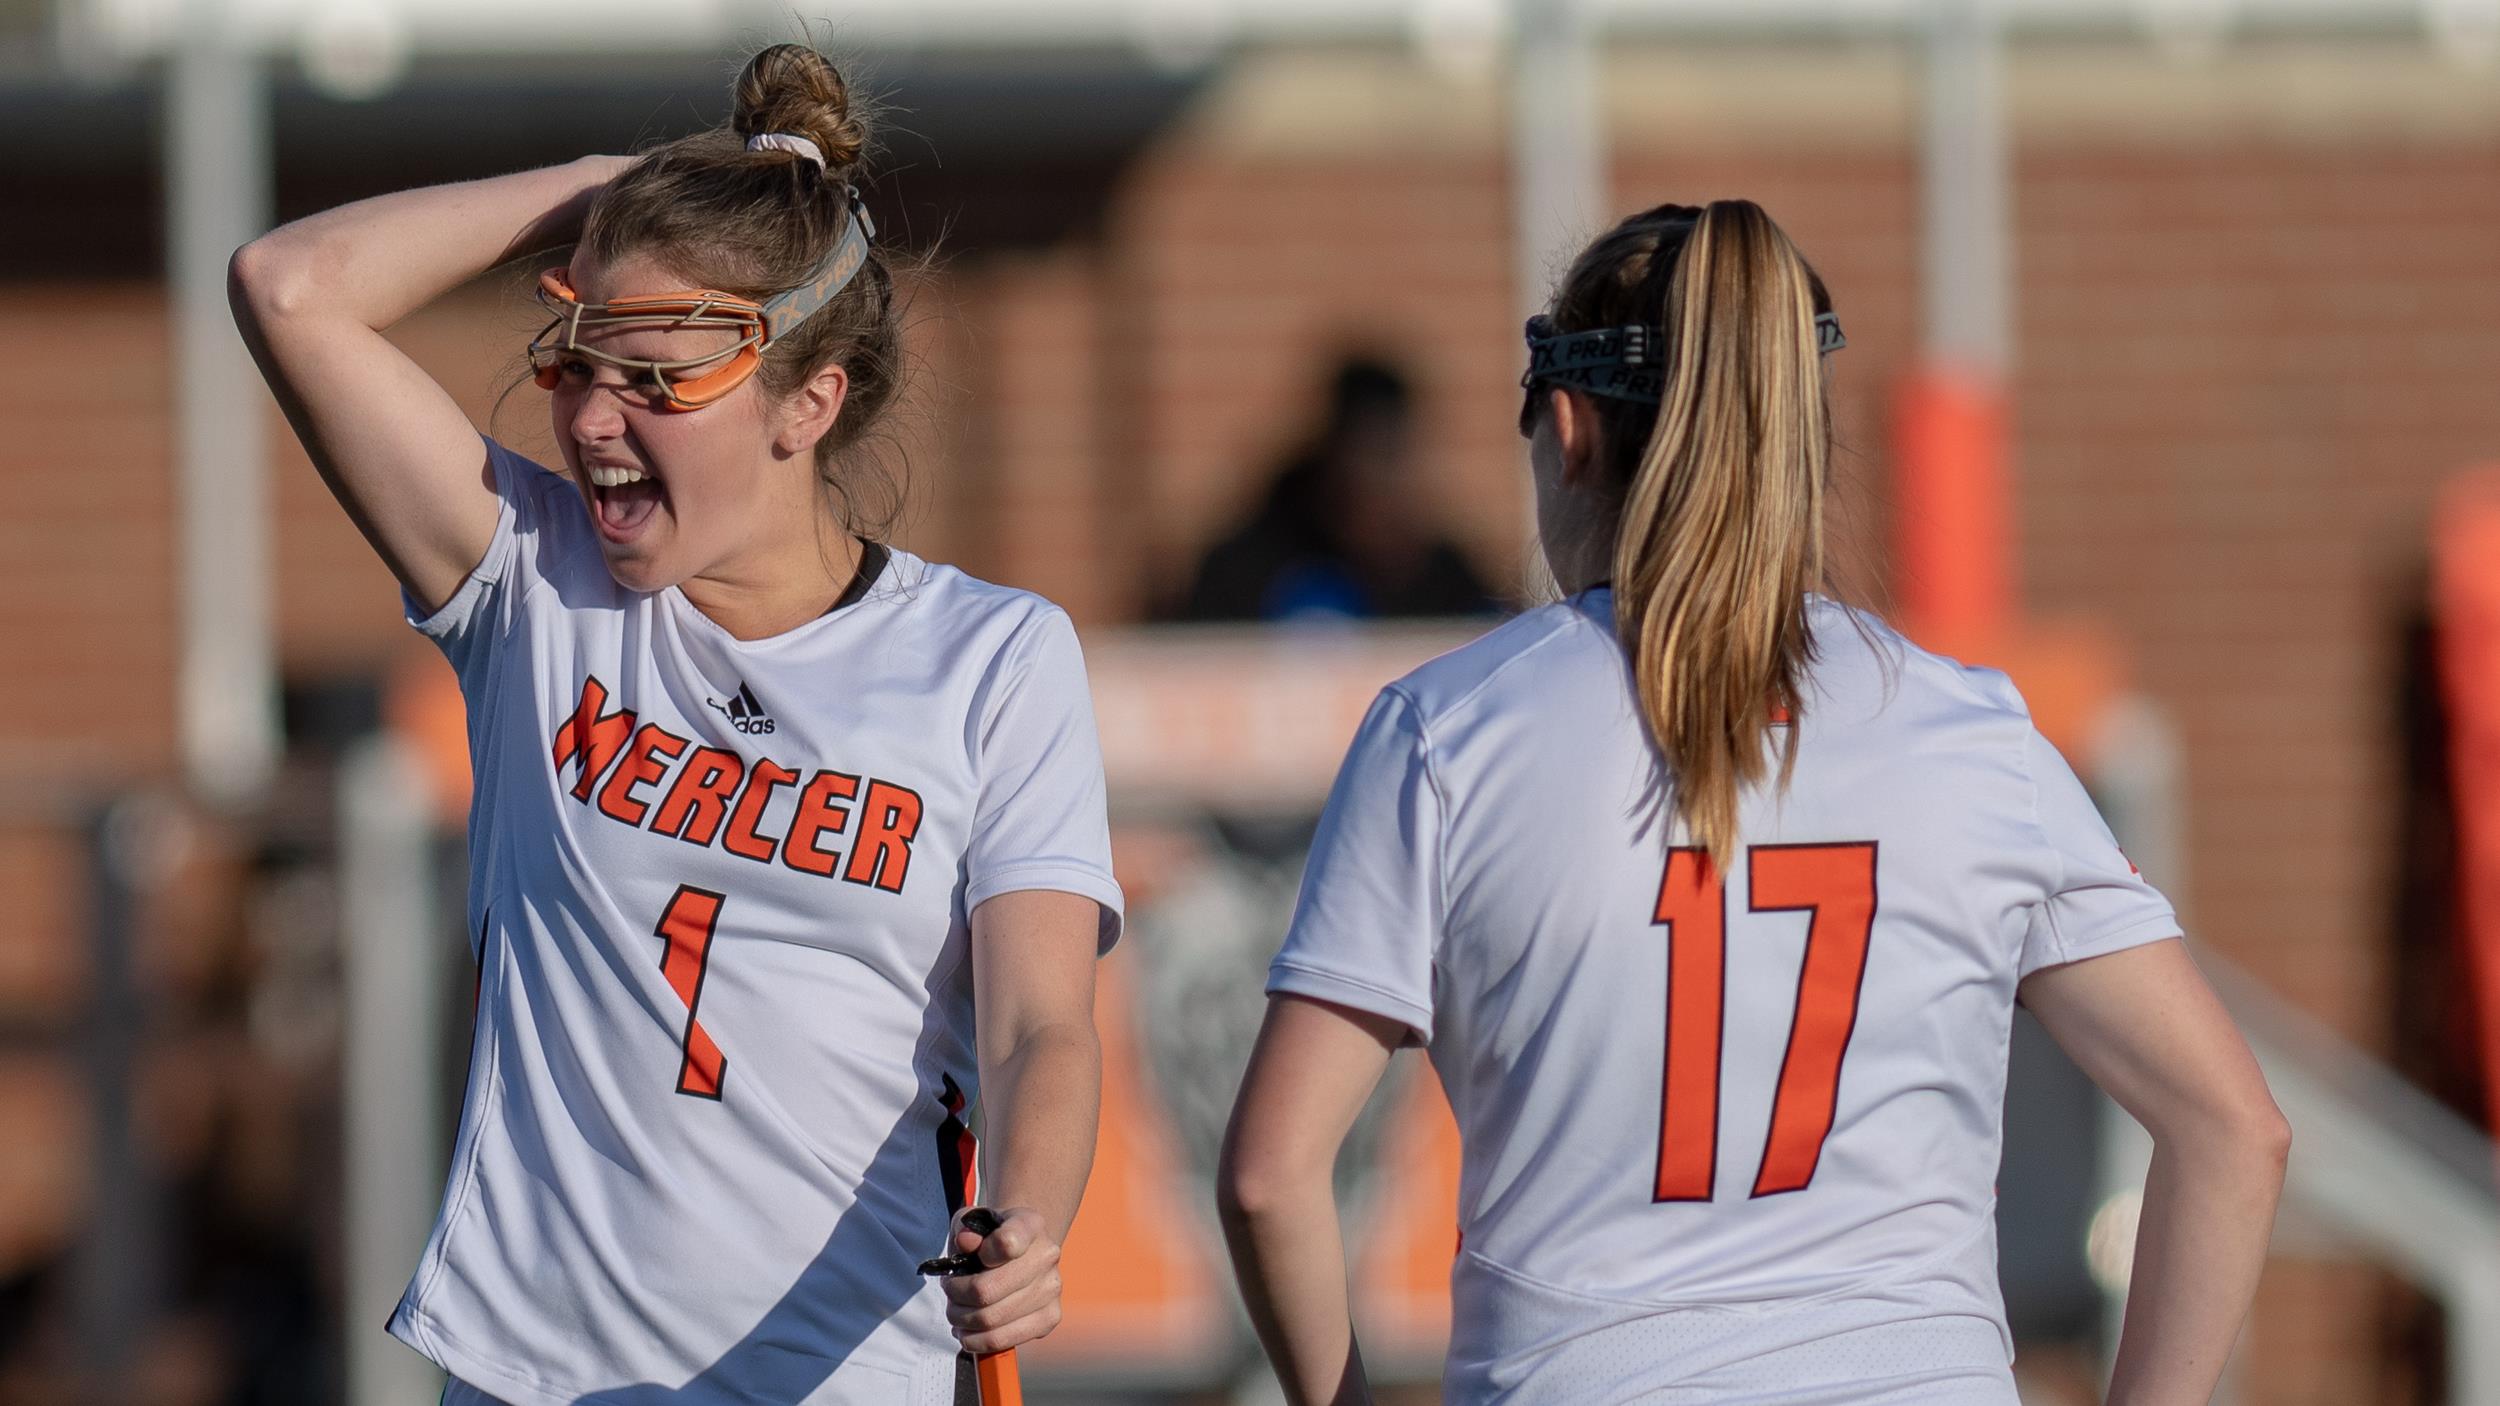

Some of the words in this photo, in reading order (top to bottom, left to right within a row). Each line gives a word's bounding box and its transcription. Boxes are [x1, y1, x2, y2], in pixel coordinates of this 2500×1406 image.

[815, 241, 859, 302] PRO
[1566, 336, 1619, 361] PRO
[552, 674, 924, 895] MERCER
[653, 883, 728, 1102] 1
[1650, 840, 1878, 1203] 17
